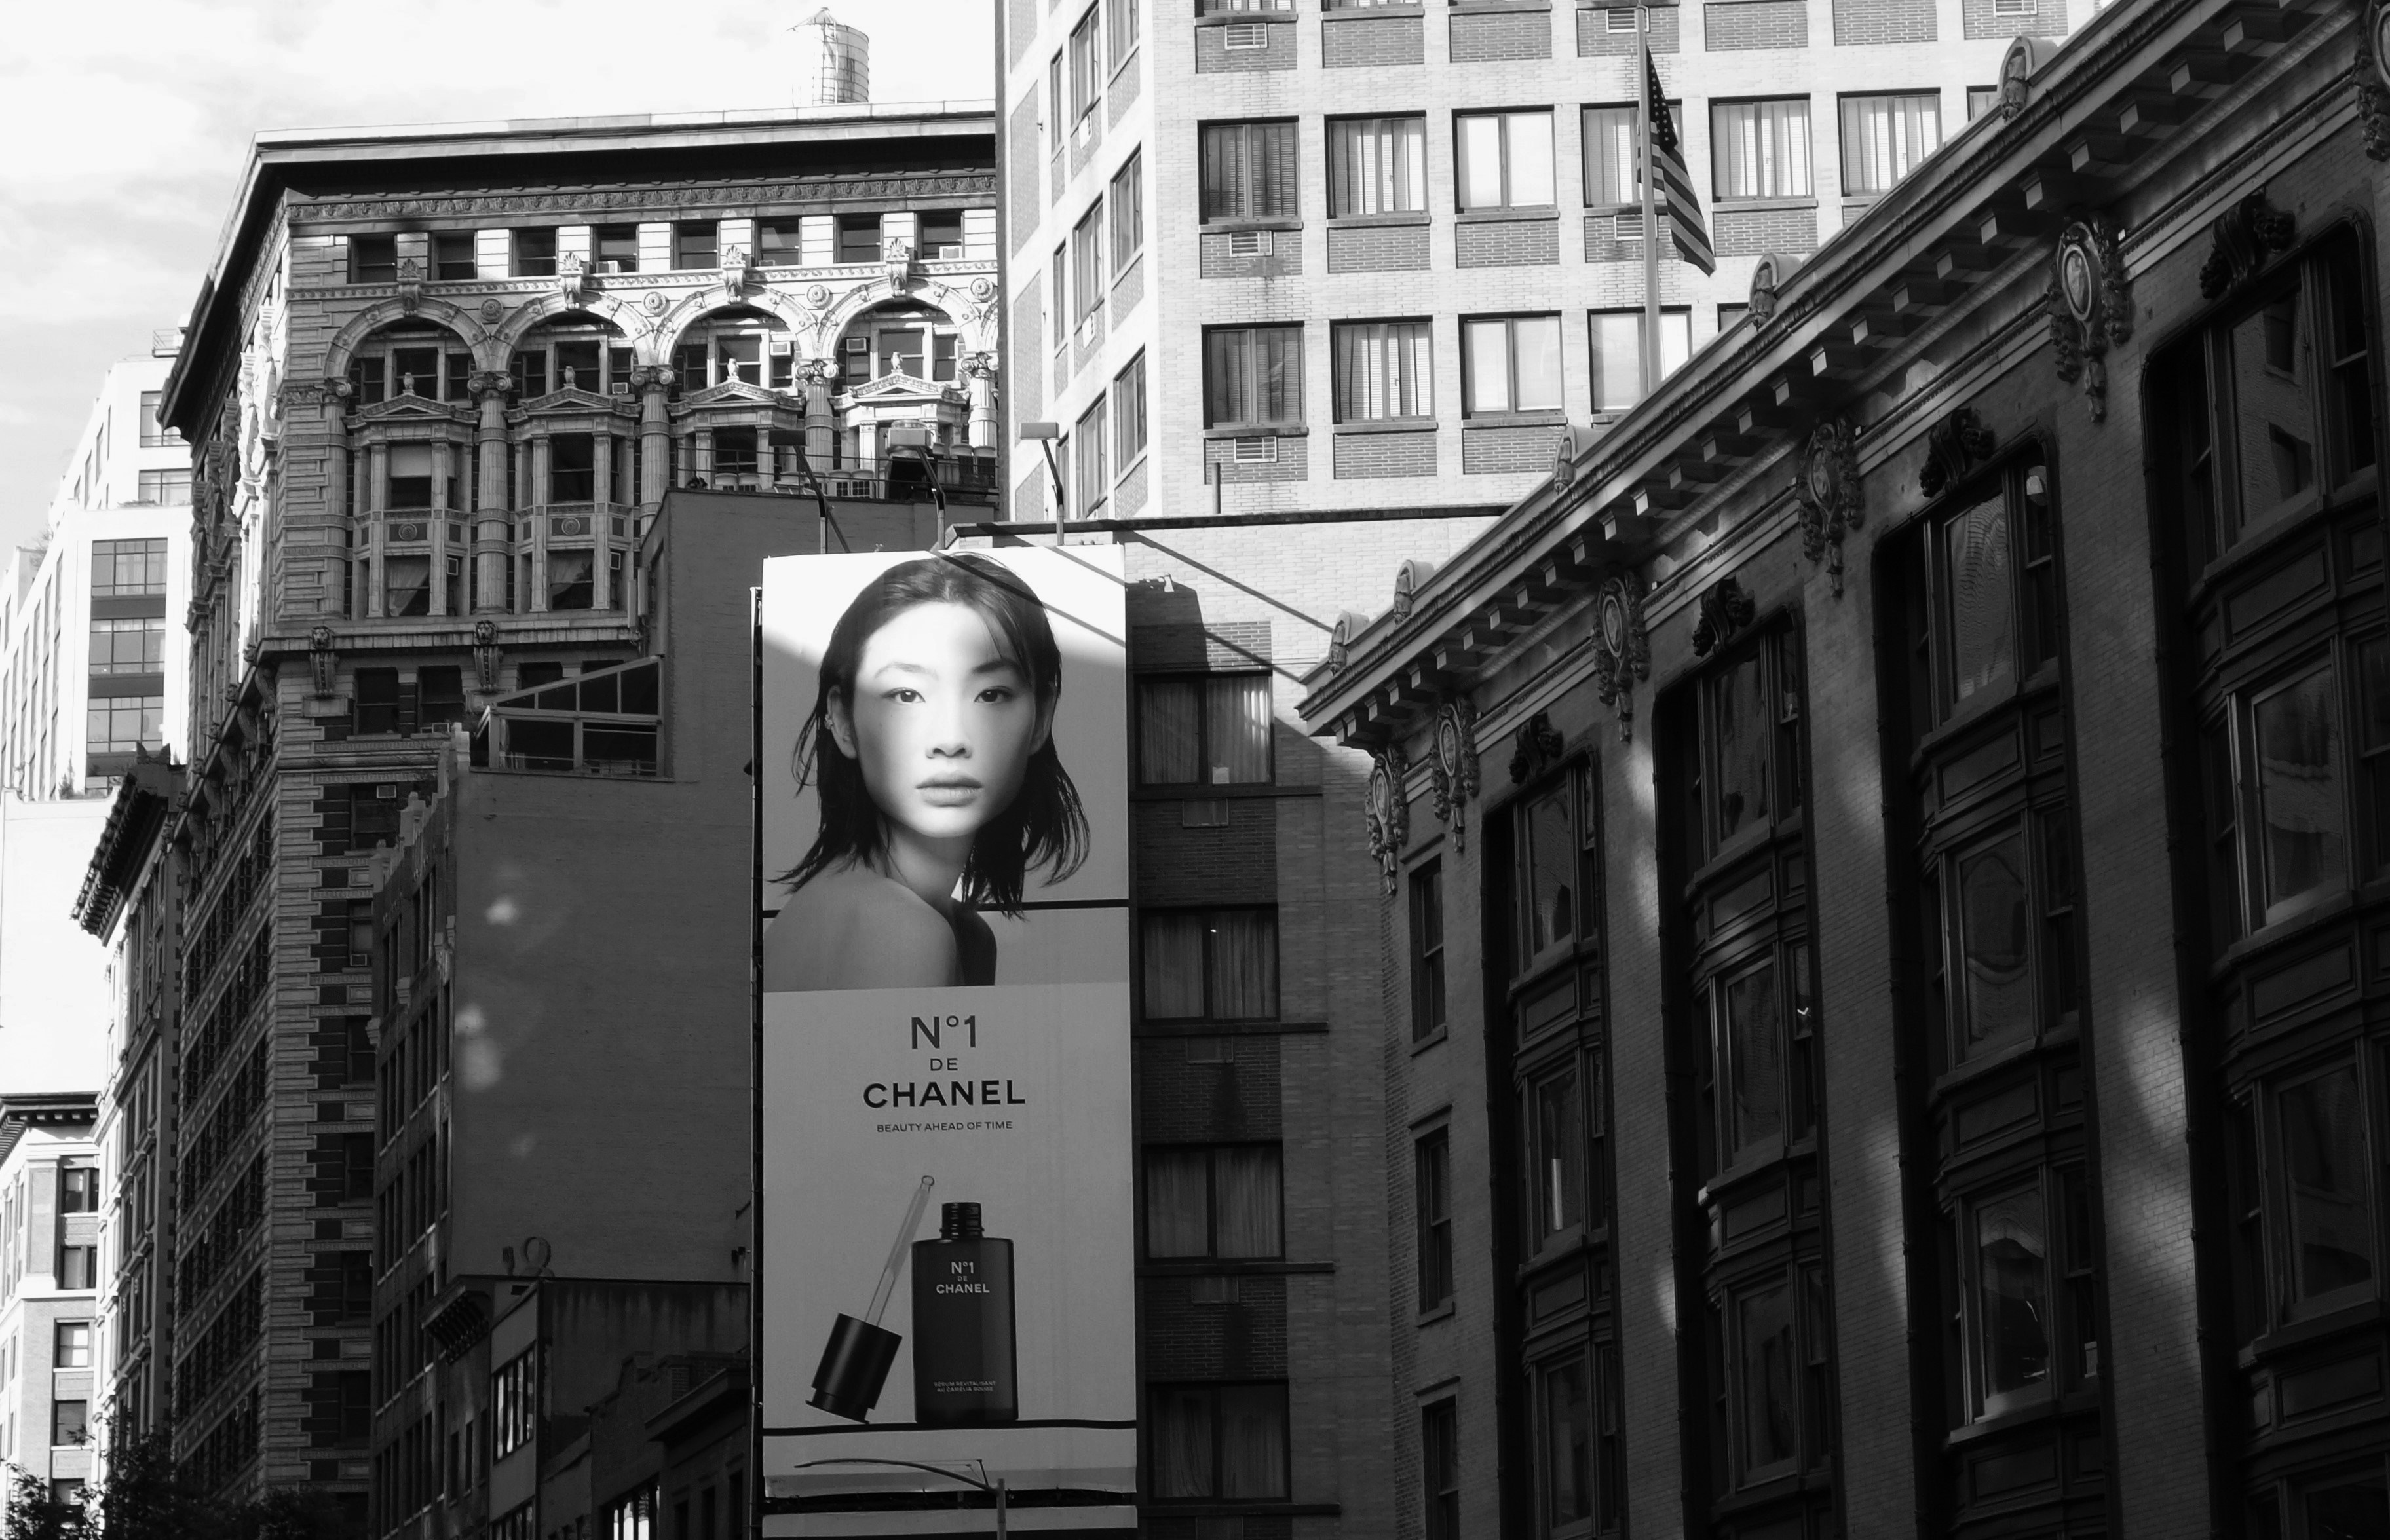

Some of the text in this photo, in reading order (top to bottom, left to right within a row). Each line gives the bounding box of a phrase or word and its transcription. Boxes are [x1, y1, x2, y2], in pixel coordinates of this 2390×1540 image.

[930, 1057, 959, 1072] DE
[863, 1080, 1026, 1108] CHANEL
[877, 1121, 1013, 1133] BEAUTY AHEAD OF TIME
[936, 1283, 990, 1294] CHANEL
